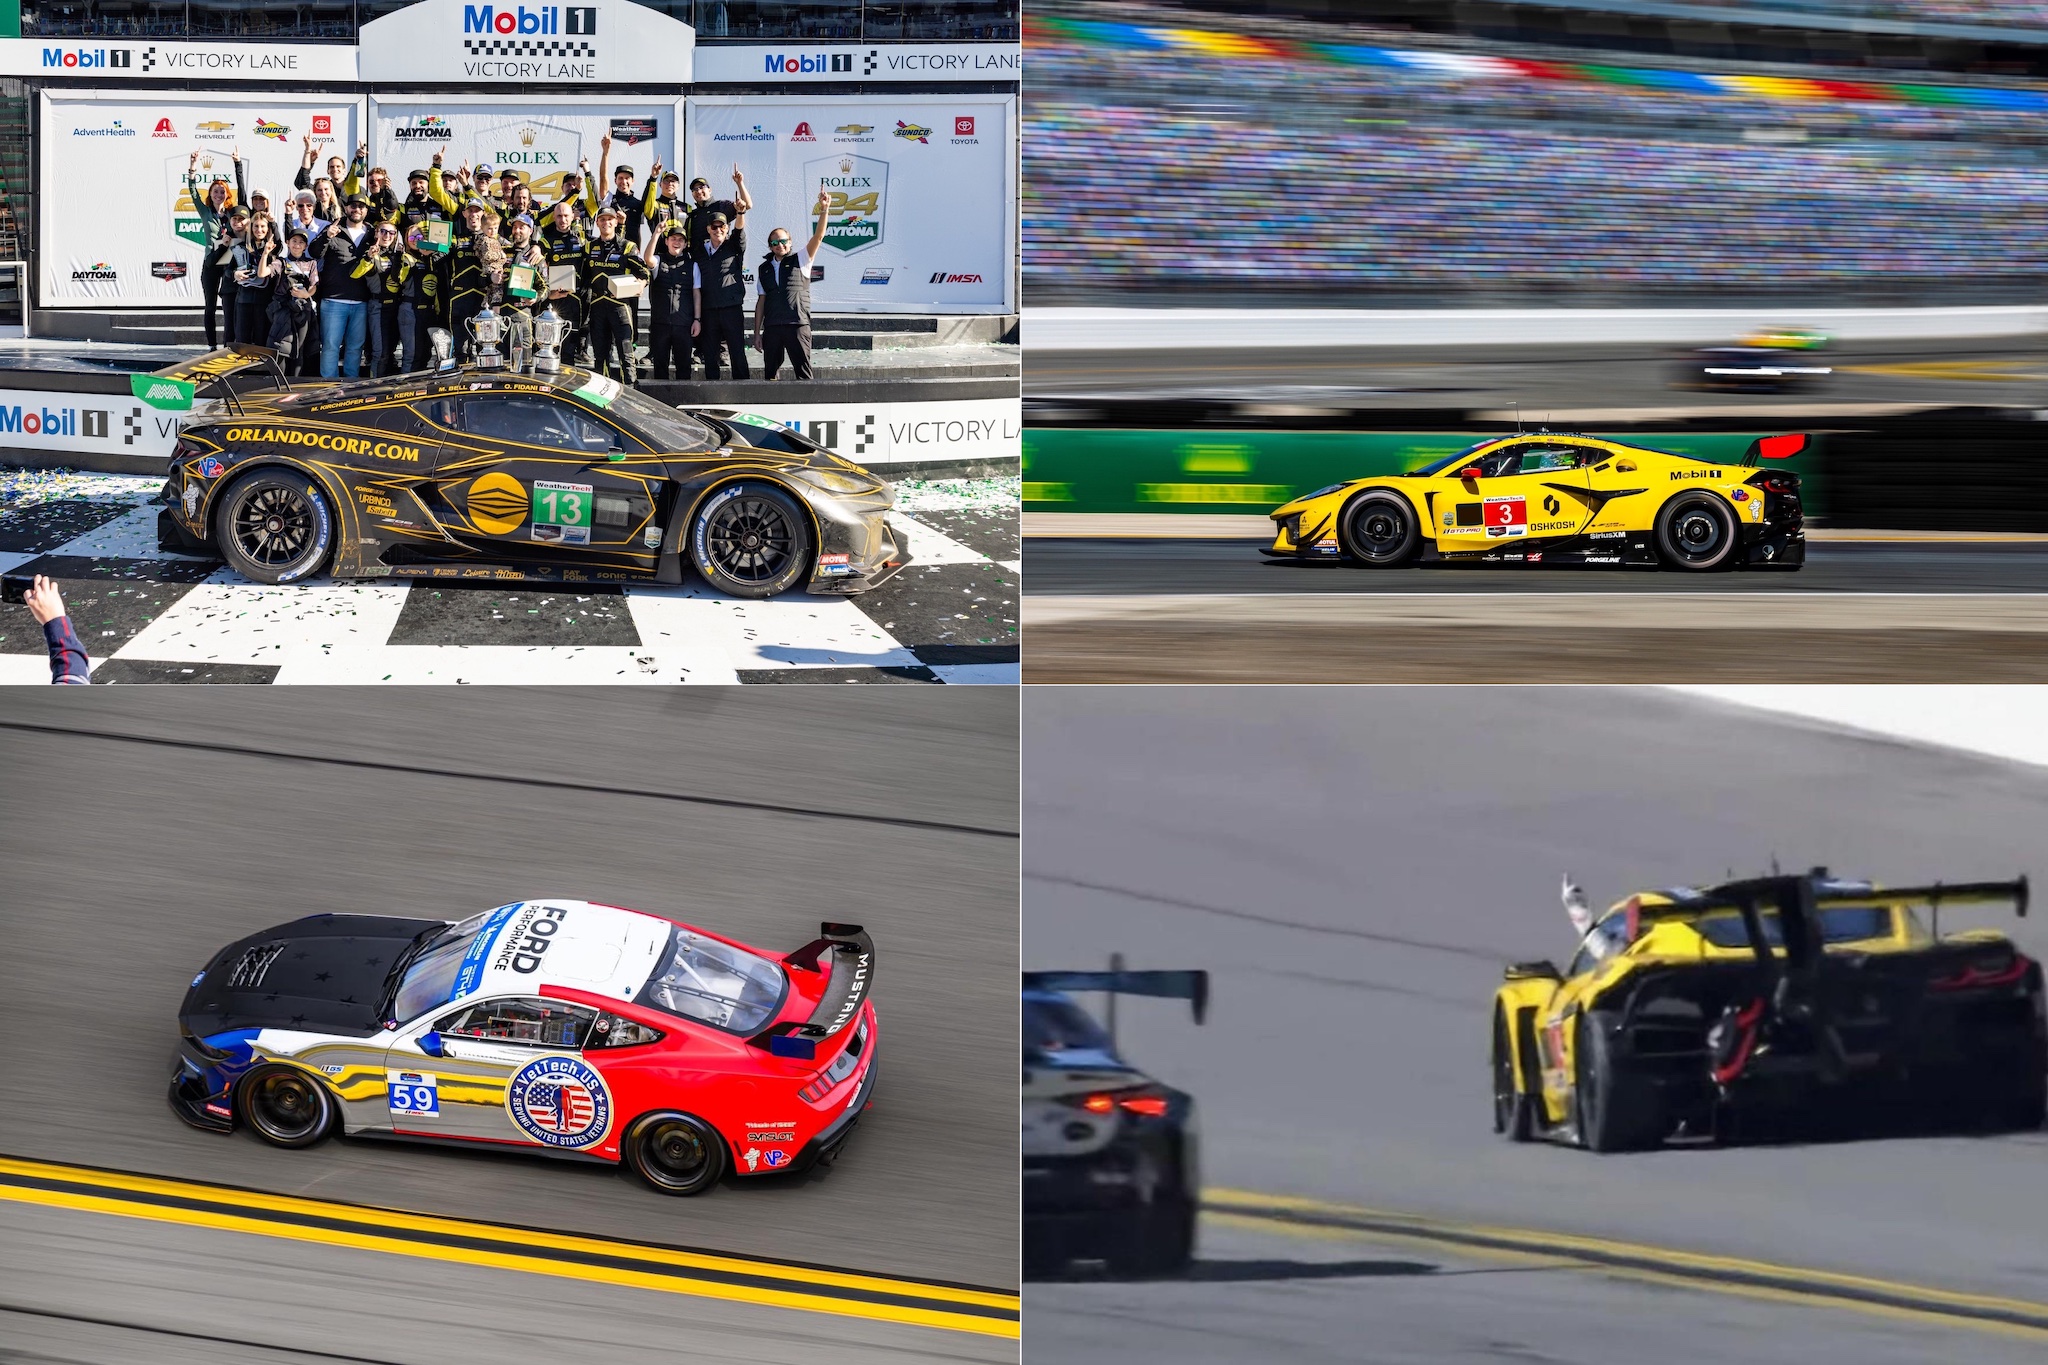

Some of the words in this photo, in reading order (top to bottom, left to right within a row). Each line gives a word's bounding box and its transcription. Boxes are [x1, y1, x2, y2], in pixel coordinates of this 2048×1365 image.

[464, 5, 558, 34] Mobil
[43, 48, 105, 68] Mobil
[165, 52, 245, 68] VICTORY
[250, 54, 298, 70] LANE
[765, 54, 827, 73] Mobil
[887, 54, 970, 69] VICTORY
[464, 62, 542, 77] VICTORY
[548, 63, 595, 78] LANE
[73, 128, 136, 136] AdventHealth
[395, 128, 452, 137] DAYTONA
[495, 152, 560, 164] ROLEX
[820, 177, 871, 187] ROLEX
[812, 192, 880, 216] 24
[947, 274, 983, 283] IMSA
[145, 384, 184, 400] AWA
[0, 406, 76, 436] Mobil
[889, 419, 996, 444] VICTORY
[226, 428, 419, 462] ORLANDOCORP.COM
[200, 458, 217, 477] VP
[1670, 470, 1707, 480] Mobil
[536, 482, 591, 492] WeatherTech
[542, 492, 582, 524] 13
[1499, 504, 1513, 524] 3
[1530, 521, 1575, 531] OSHKOSH
[697, 520, 706, 560] MICHELIN
[494, 905, 540, 971] PERFORMANCE
[512, 906, 568, 974] FORD
[457, 966, 473, 991] GT4
[826, 953, 869, 1034] MUSTANG
[517, 1060, 599, 1091] VetTech.US
[394, 1085, 433, 1110] 59
[208, 1104, 231, 1115] MOTUL
[513, 1097, 531, 1127] SERVING
[530, 1126, 558, 1143] UNITED
[560, 1135, 588, 1145] STATES
[586, 1106, 606, 1139] VETERANS
[765, 1150, 783, 1166] VP
